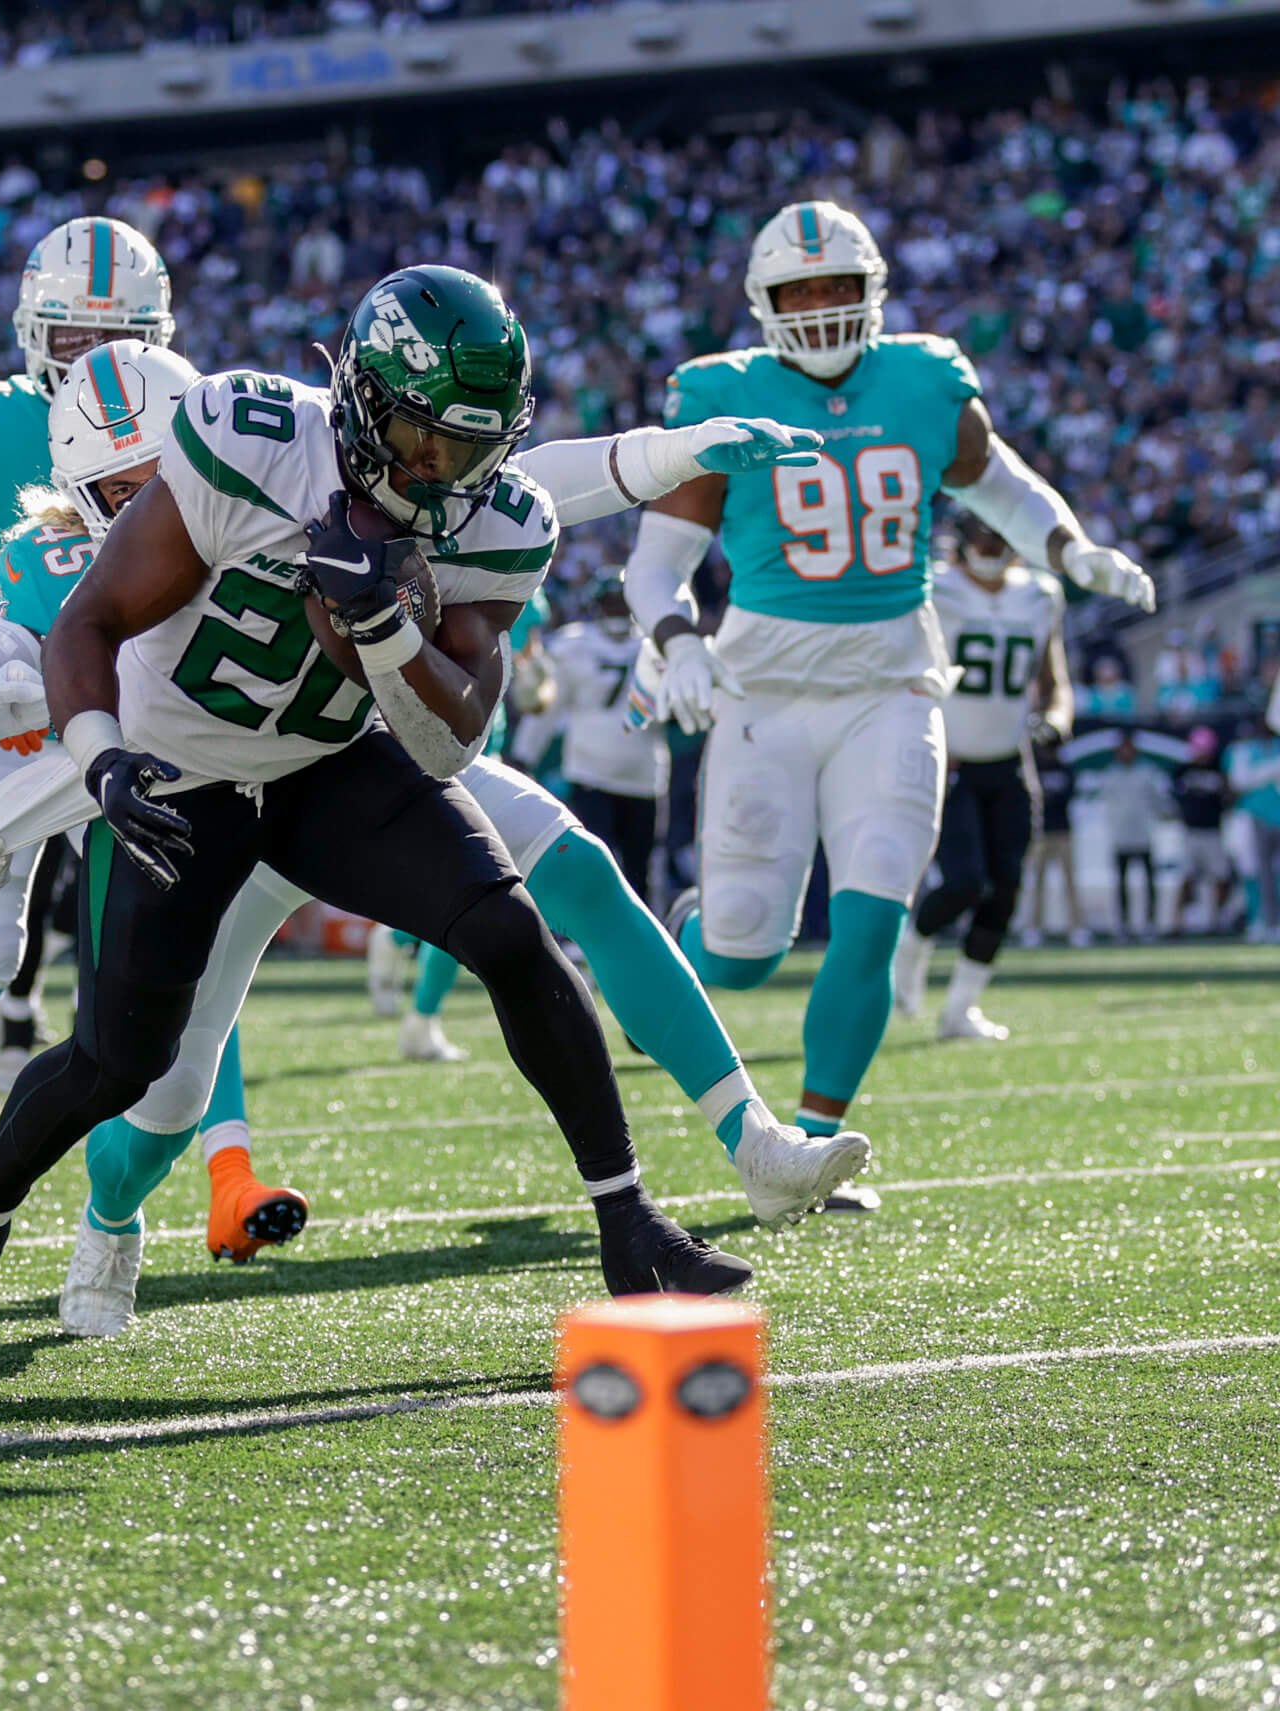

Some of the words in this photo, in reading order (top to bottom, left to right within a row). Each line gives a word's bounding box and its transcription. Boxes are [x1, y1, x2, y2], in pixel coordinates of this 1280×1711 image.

[370, 289, 440, 373] JETS
[113, 432, 142, 451] MIAMI
[772, 443, 923, 581] 98
[33, 524, 97, 577] 45
[245, 552, 301, 579] NE
